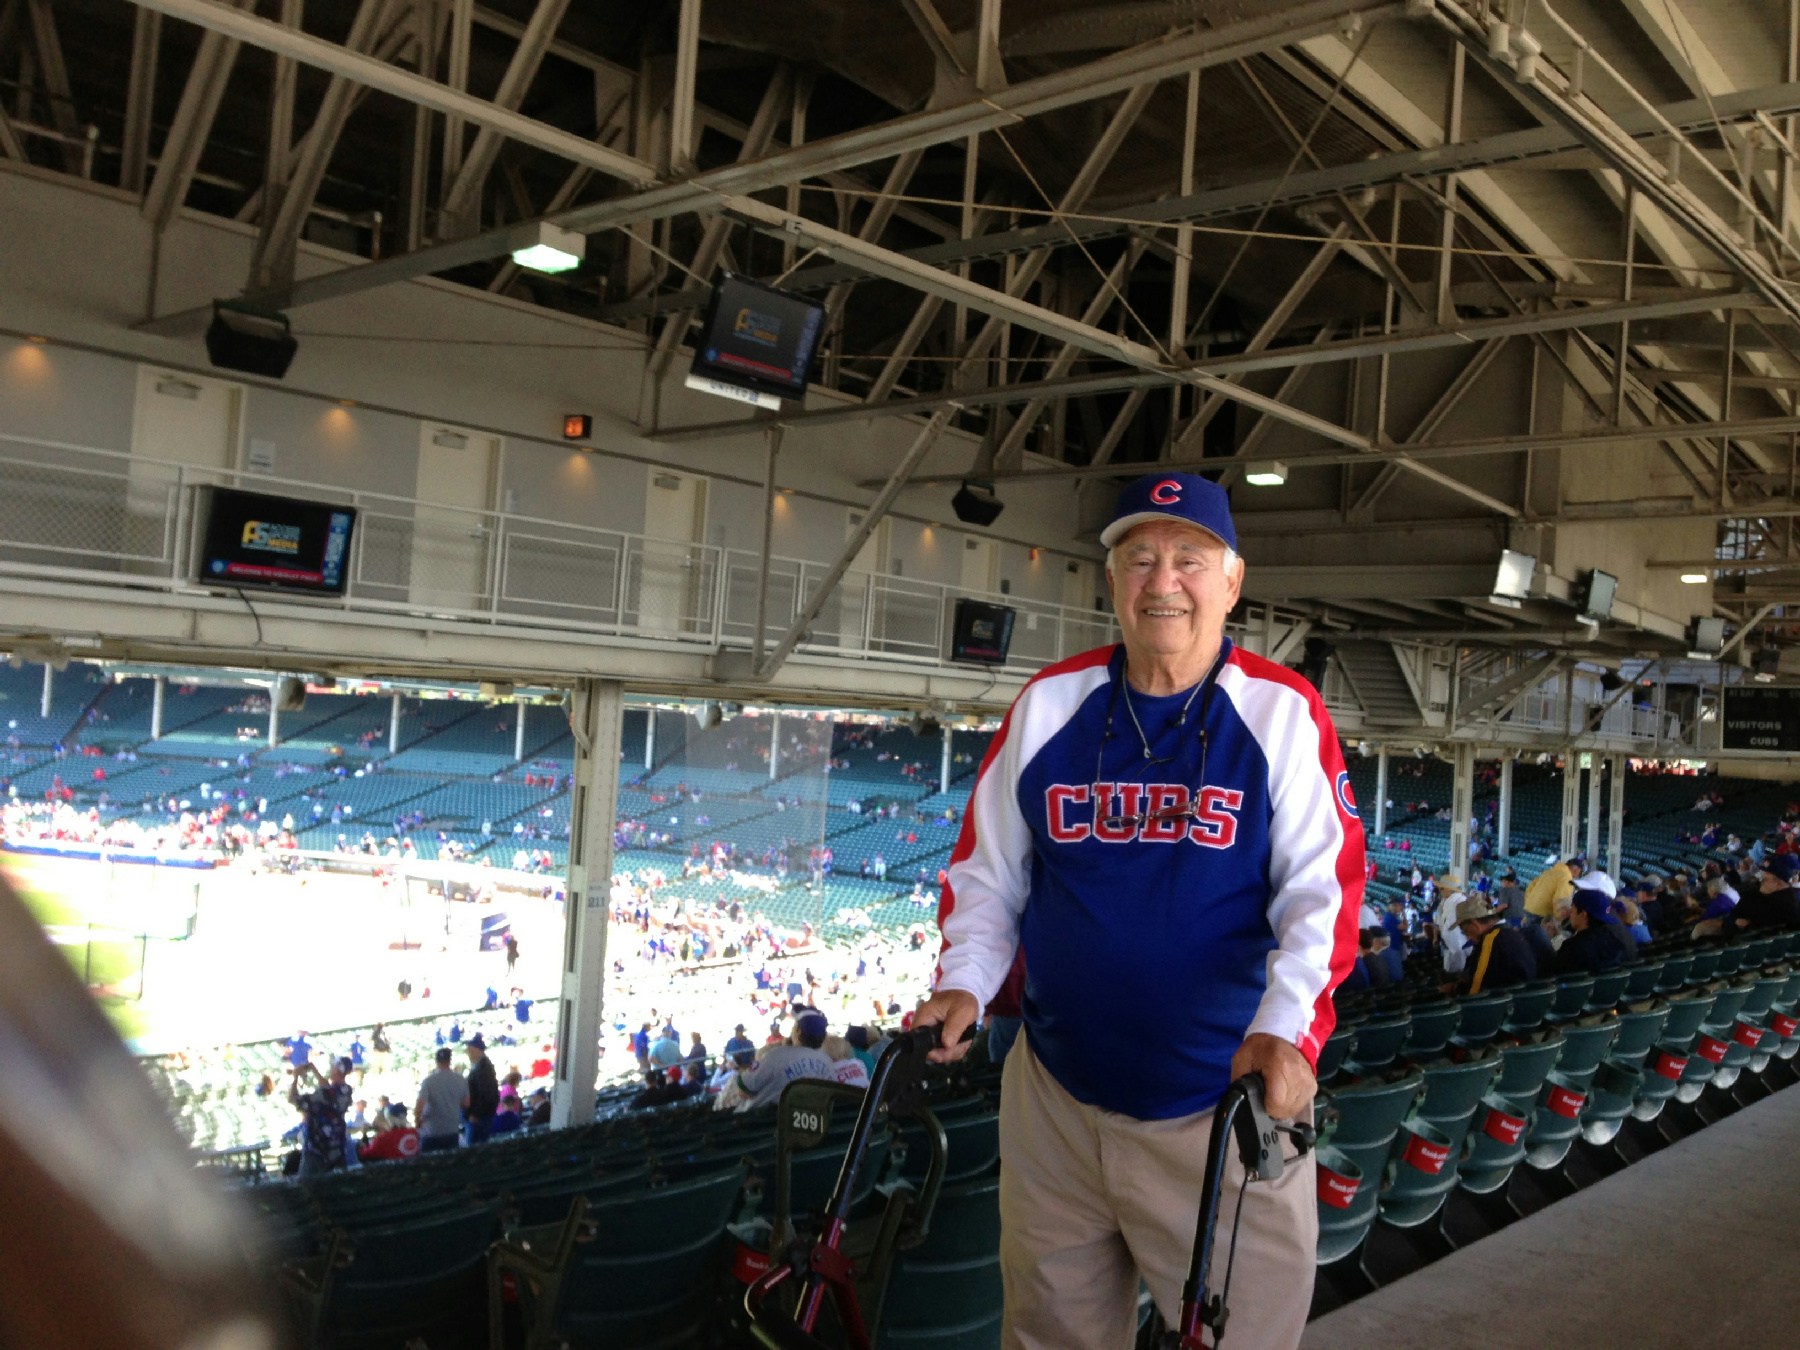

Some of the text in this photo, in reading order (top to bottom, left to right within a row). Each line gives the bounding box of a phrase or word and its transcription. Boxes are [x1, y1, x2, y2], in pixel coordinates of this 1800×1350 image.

[1150, 480, 1182, 505] C
[1728, 720, 1782, 731] VISITORS
[1750, 737, 1779, 746] CUBS
[1045, 783, 1244, 849] CUBS
[588, 896, 605, 908] 211
[792, 1111, 817, 1131] 209
